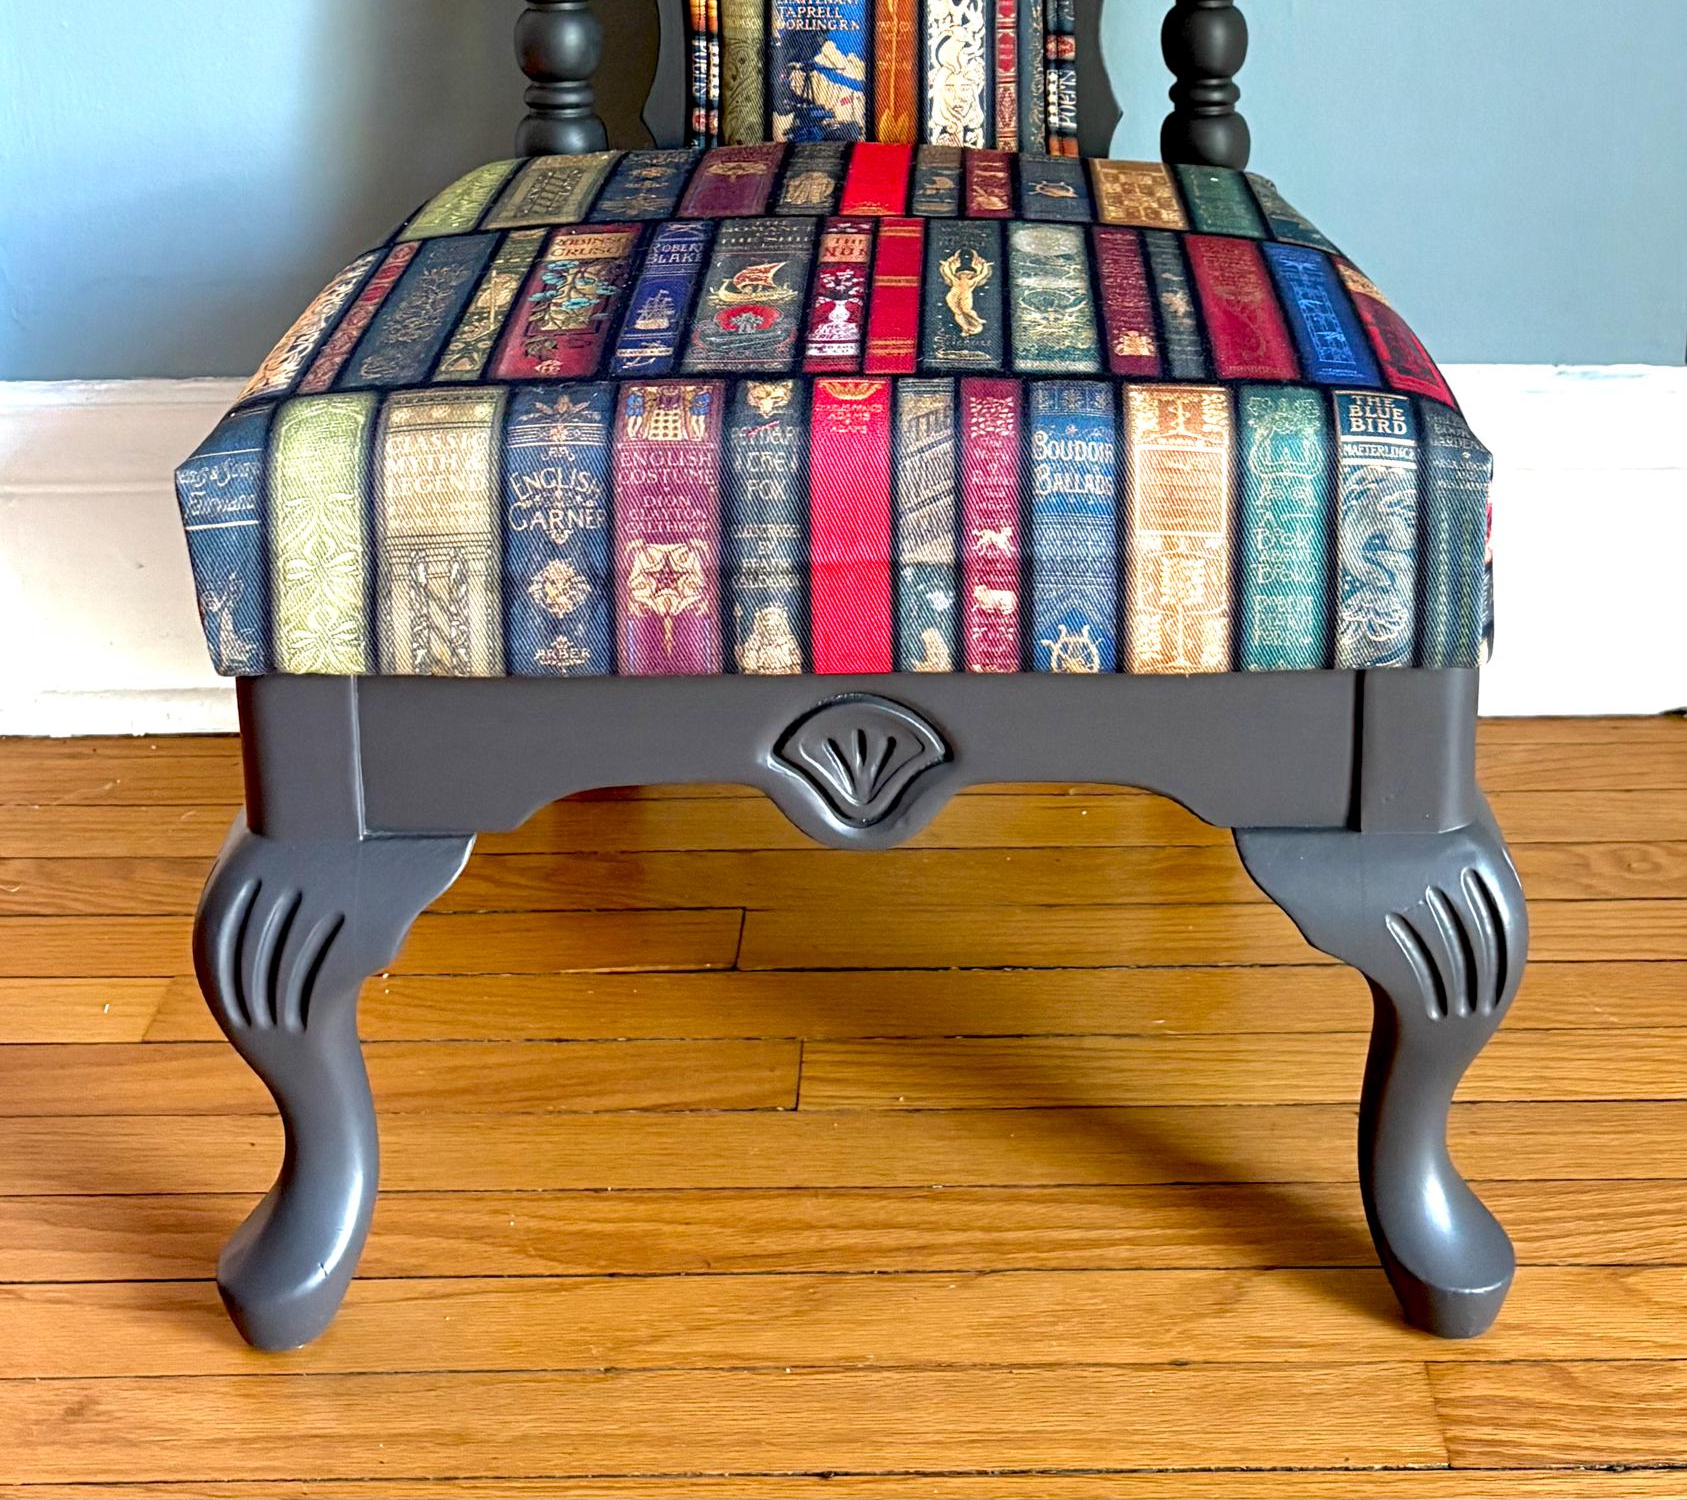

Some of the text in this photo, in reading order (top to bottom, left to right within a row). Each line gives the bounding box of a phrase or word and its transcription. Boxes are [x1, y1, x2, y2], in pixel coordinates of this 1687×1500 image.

[777, 6, 842, 18] TAPRELL
[1351, 396, 1394, 407] THE
[1349, 405, 1405, 420] BLUE
[1350, 418, 1408, 435] BIRD
[386, 432, 488, 457] CLASSIC
[621, 451, 712, 467] ENGLISH
[619, 468, 716, 484] COSTUME
[387, 473, 487, 497] LEGEND
